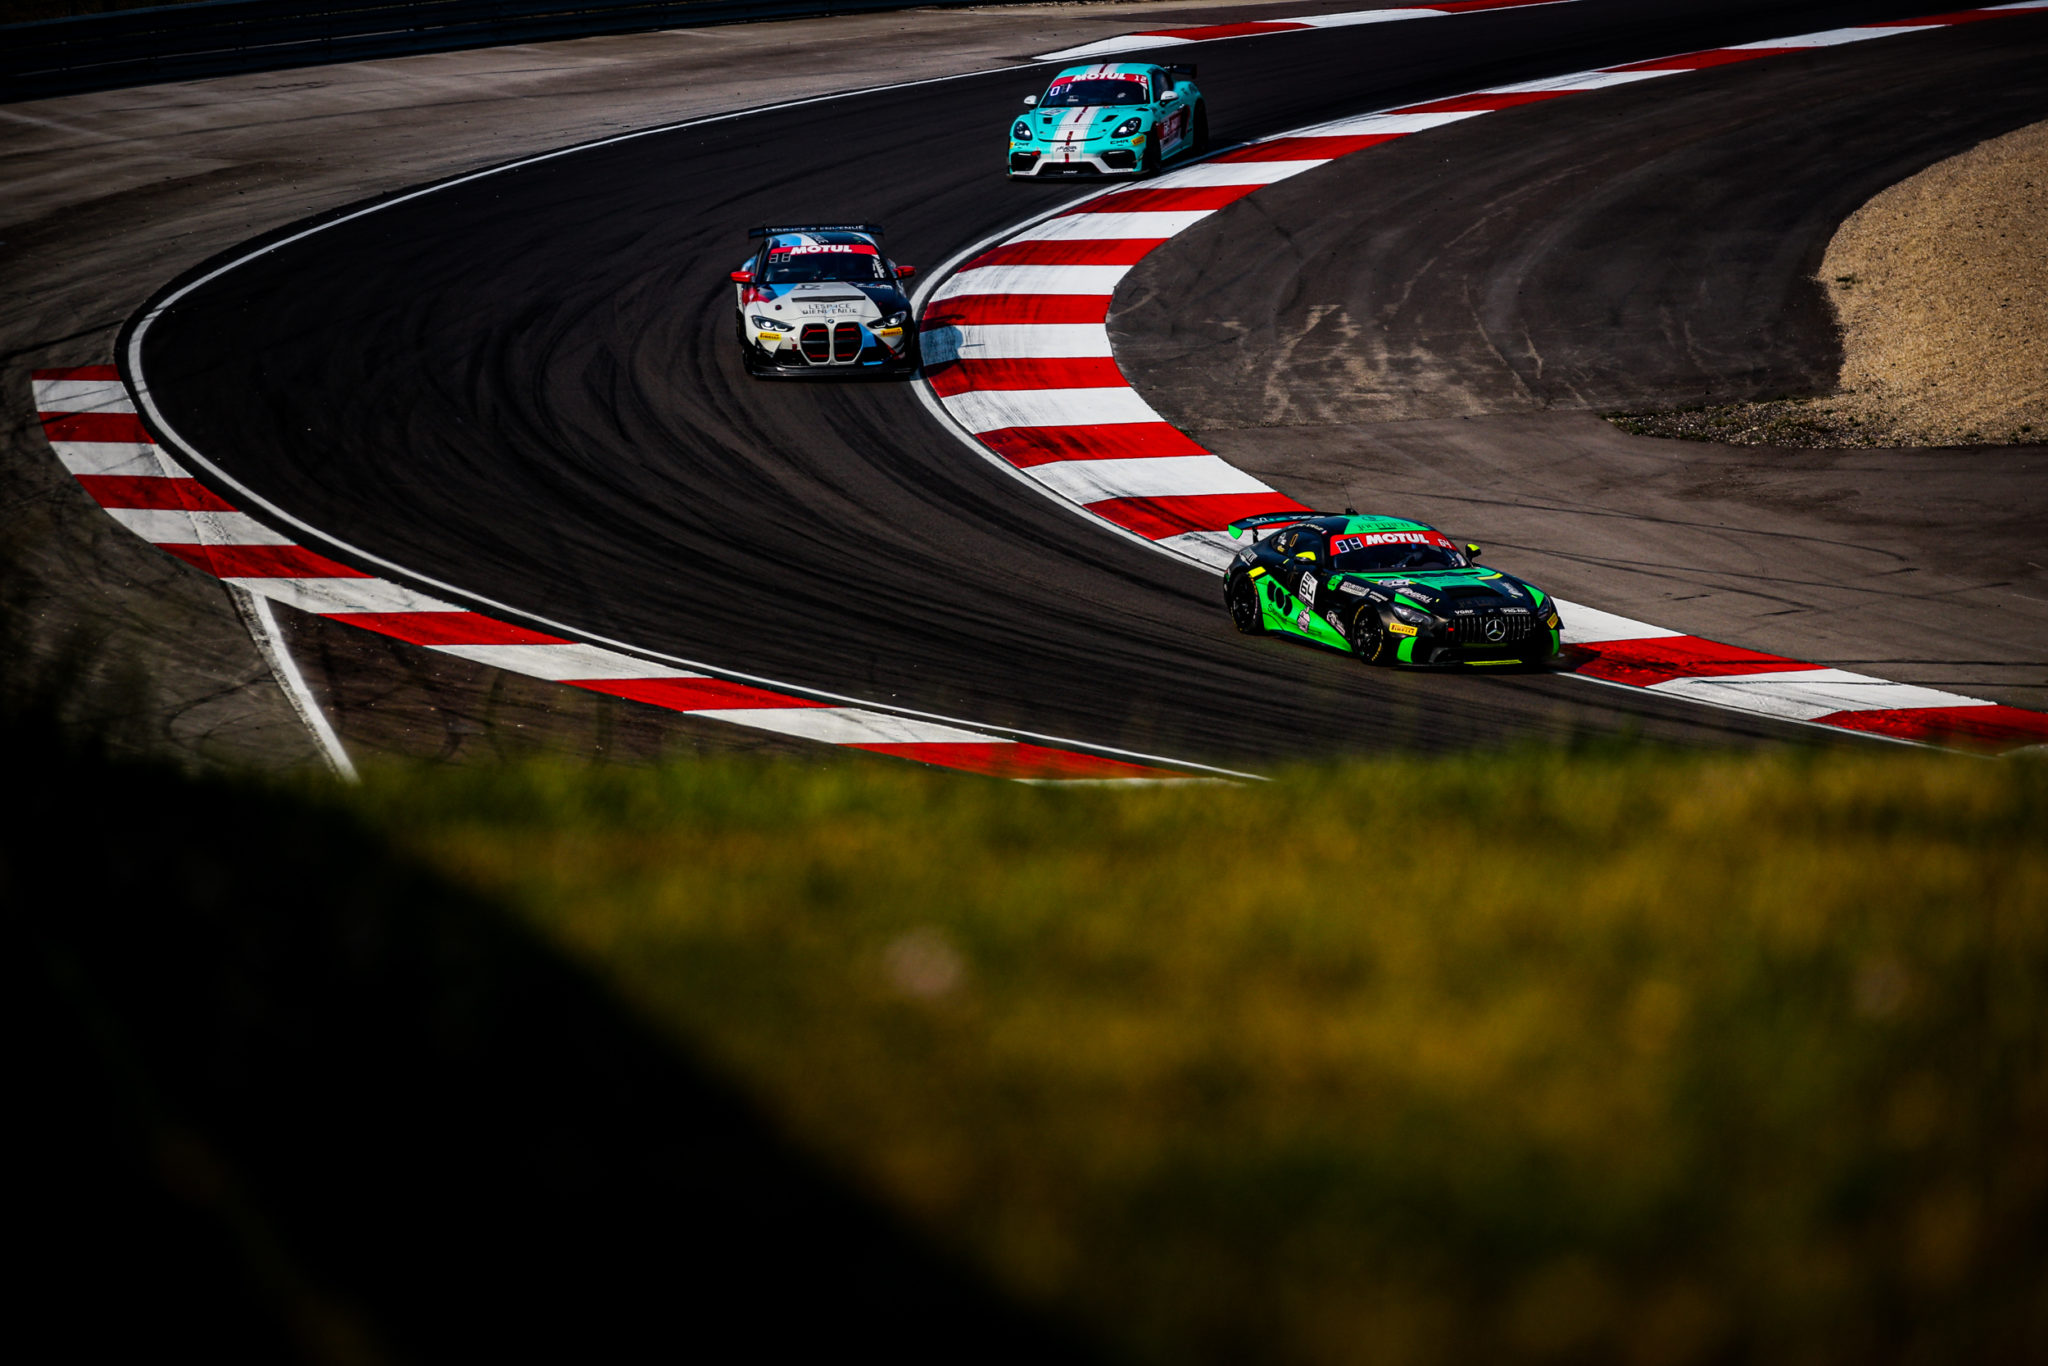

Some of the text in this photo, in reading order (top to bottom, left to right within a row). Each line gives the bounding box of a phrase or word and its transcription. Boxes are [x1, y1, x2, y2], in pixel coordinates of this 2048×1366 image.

[1072, 73, 1126, 82] MOTUL
[790, 244, 853, 255] MOTUL
[1366, 534, 1429, 545] MOTUL
[1300, 579, 1315, 601] 64
[1391, 624, 1416, 635] PIRELLI
